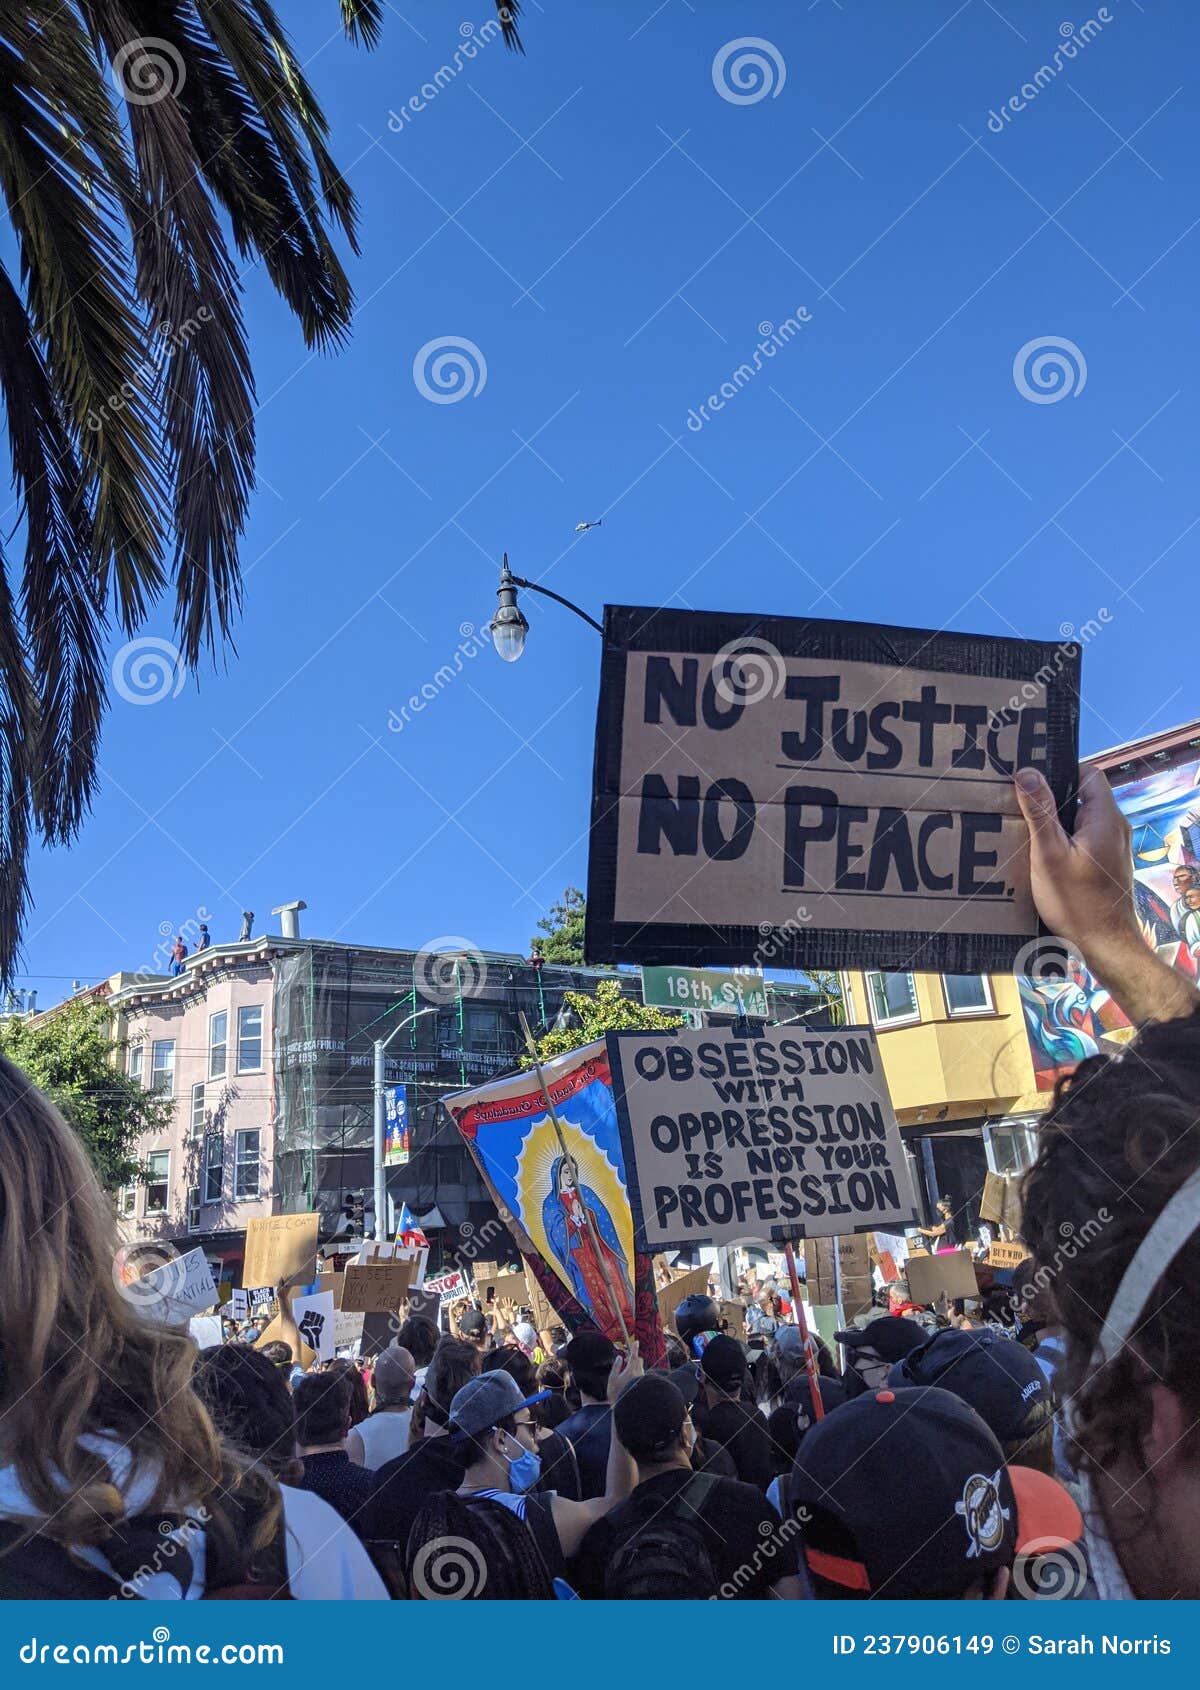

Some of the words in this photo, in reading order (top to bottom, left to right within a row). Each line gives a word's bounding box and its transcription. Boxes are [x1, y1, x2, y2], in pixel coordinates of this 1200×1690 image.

[643, 656, 748, 731] NO
[637, 774, 756, 860] NO
[667, 976, 713, 1001] 18th
[721, 982, 744, 1003] St
[634, 1038, 875, 1081] OBSESSION
[712, 1077, 804, 1103] WITH
[650, 1101, 887, 1153] OPPRESSION
[686, 1152, 723, 1179] IS
[747, 1148, 807, 1175] NOT
[816, 1143, 890, 1171] YOUR
[654, 1169, 901, 1229] PROFESSION
[428, 1272, 461, 1292] STOP
